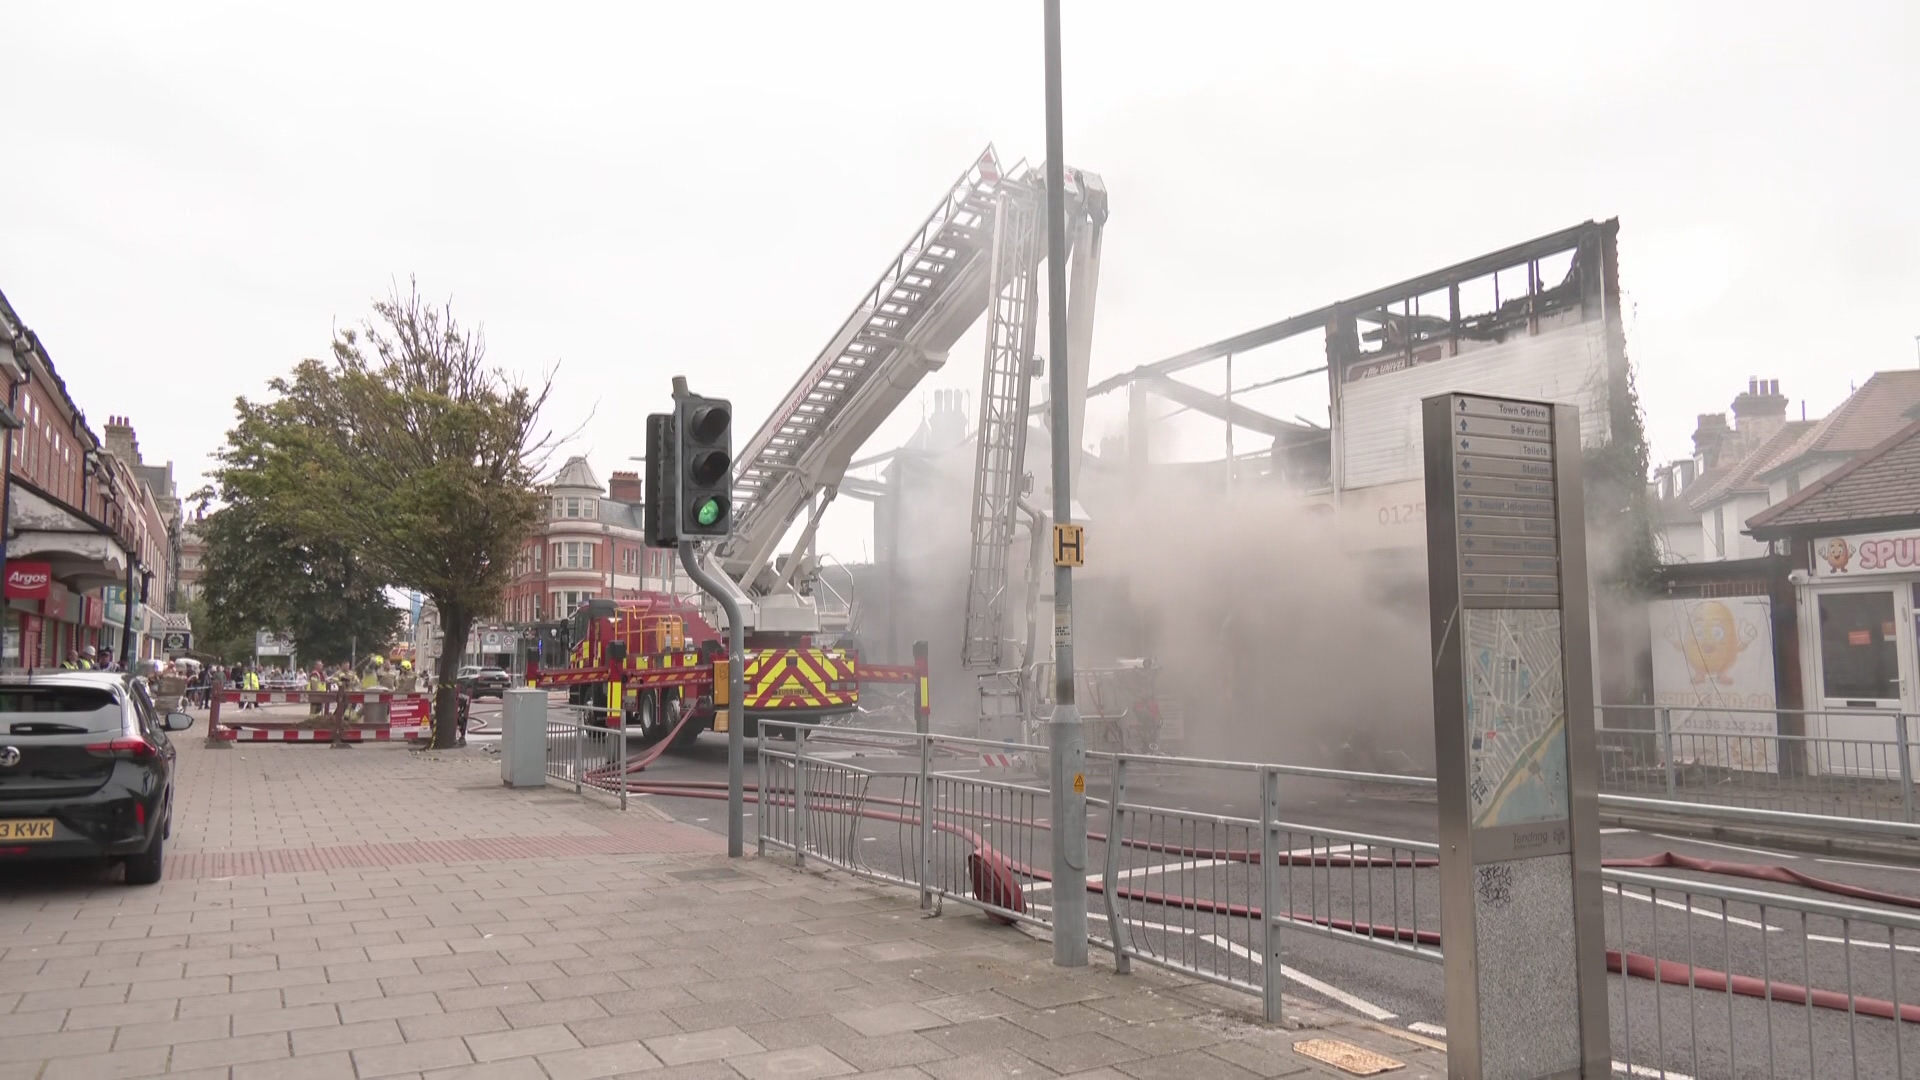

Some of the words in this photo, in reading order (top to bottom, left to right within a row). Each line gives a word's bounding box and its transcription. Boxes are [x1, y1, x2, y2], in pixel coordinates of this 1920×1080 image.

[1499, 404, 1519, 415] Town
[1520, 407, 1546, 419] Centre
[1510, 425, 1525, 435] Sea
[1527, 426, 1547, 438] Front
[1523, 445, 1547, 456] Toilets
[1522, 464, 1549, 474] Station
[1513, 483, 1533, 493] Town
[1059, 528, 1080, 562] H
[9, 571, 47, 585] Argos
[15, 822, 51, 837] KVK
[1513, 831, 1548, 845] Tendring
